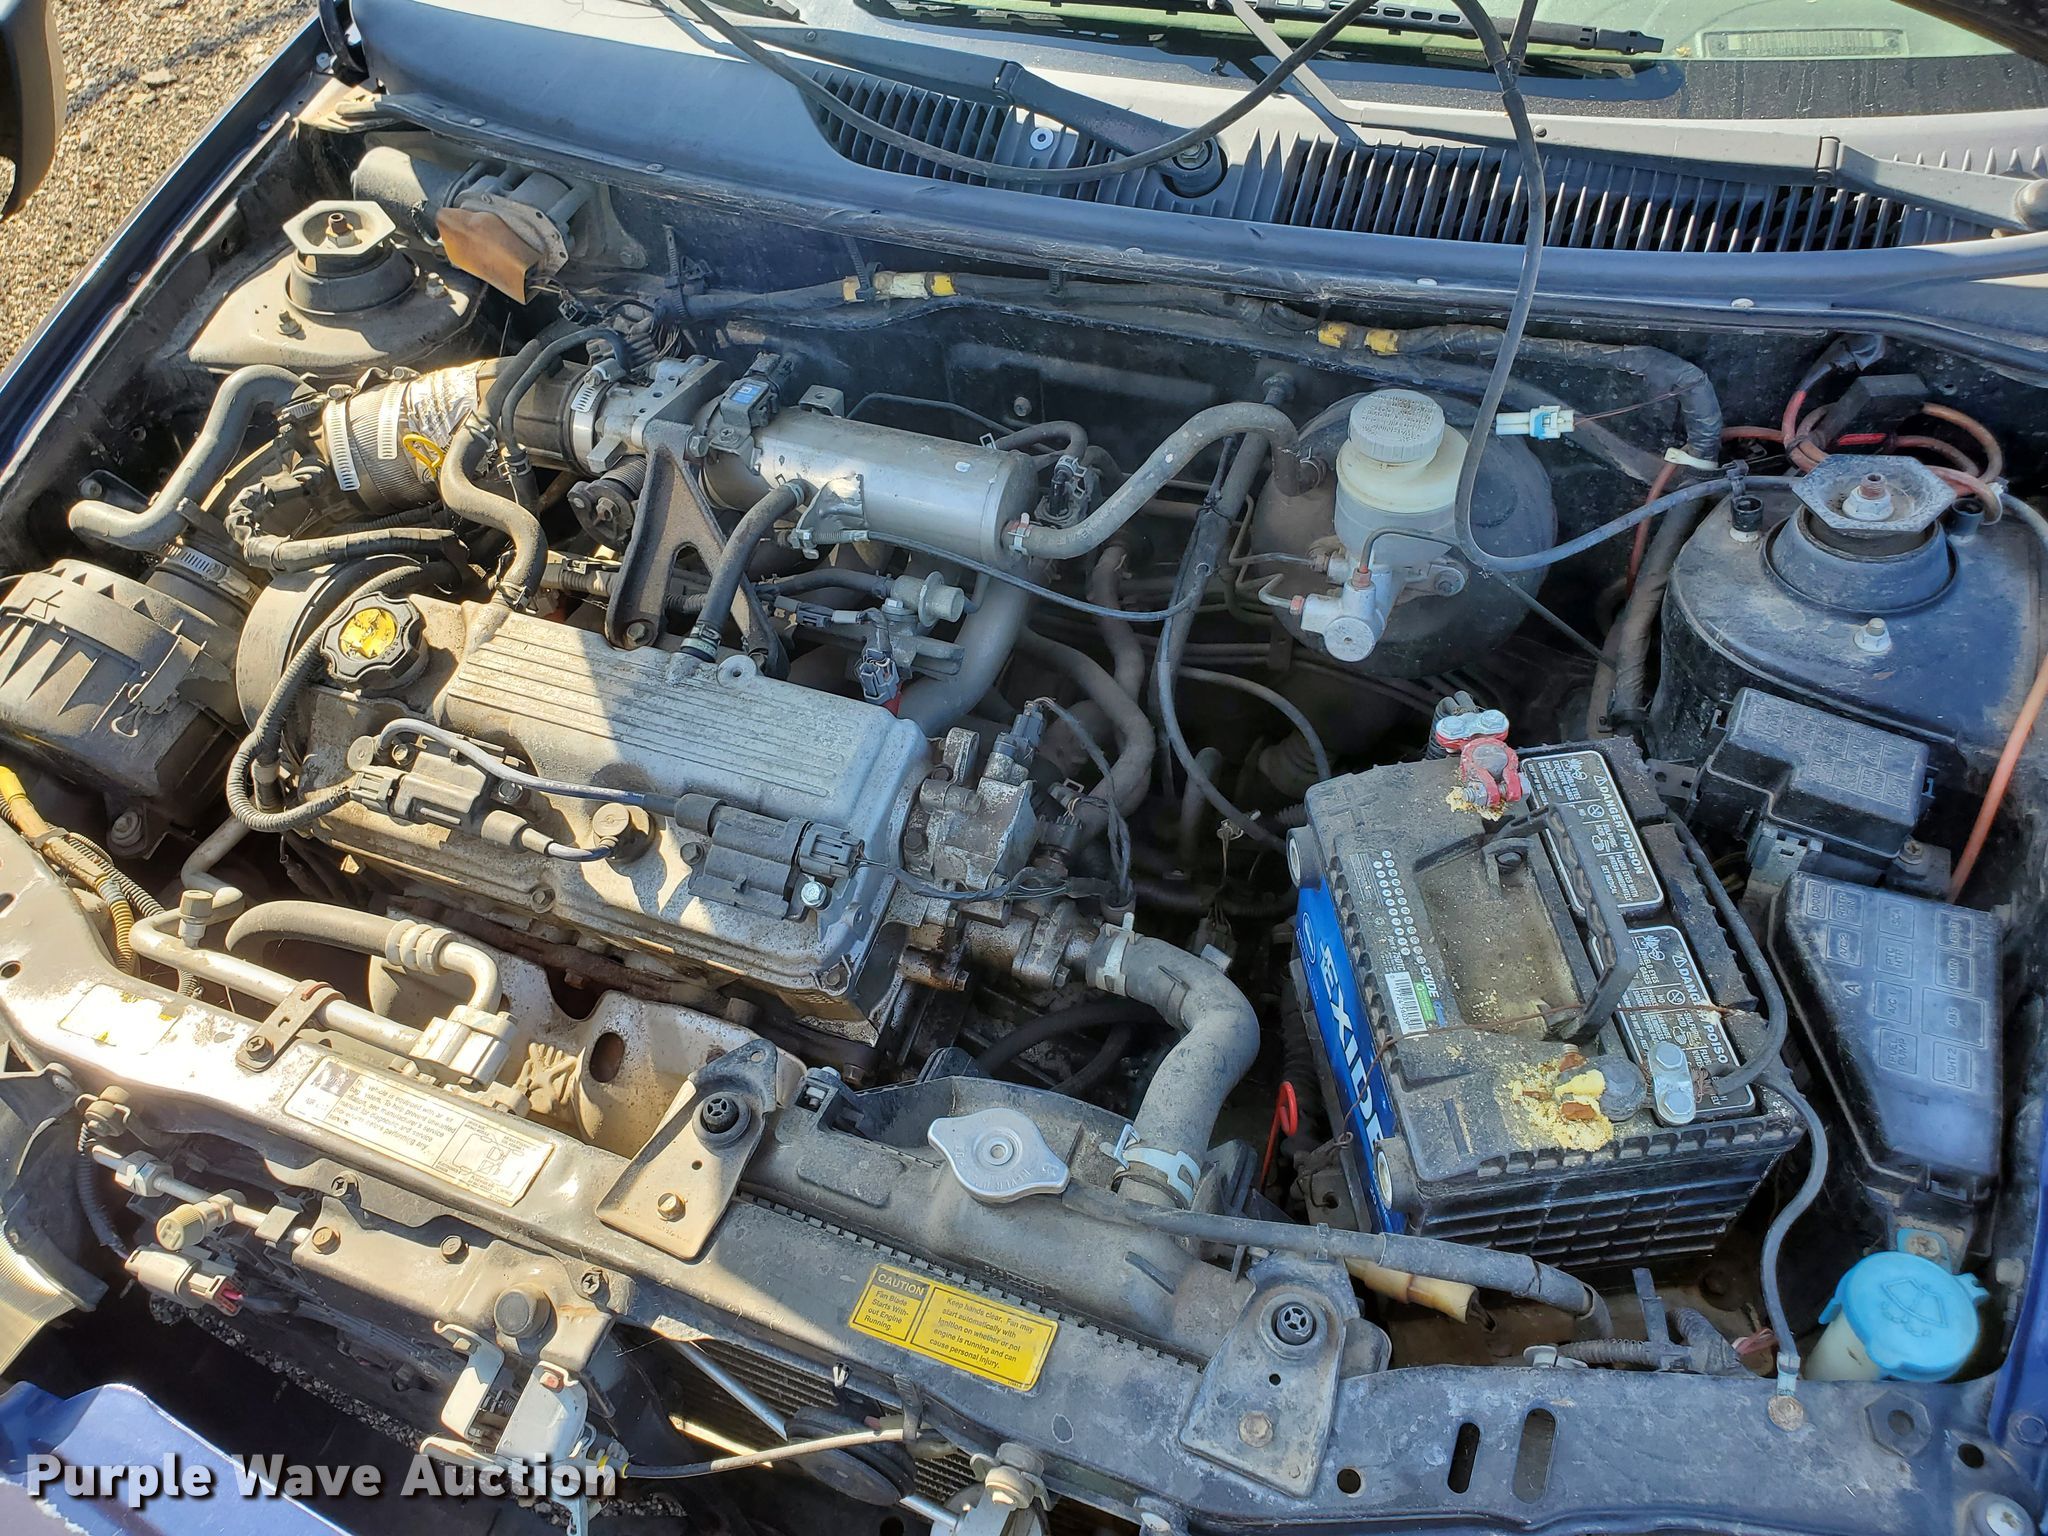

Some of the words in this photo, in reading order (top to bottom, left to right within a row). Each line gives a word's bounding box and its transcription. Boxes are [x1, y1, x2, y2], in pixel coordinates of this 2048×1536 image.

[1594, 824, 1605, 836] ACID
[1599, 786, 1625, 831] DANGER/
[1620, 835, 1644, 873] POISON
[1602, 824, 1617, 847] SULFURIC
[1614, 854, 1627, 869] FLUSH
[1622, 871, 1633, 883] EYES
[1628, 884, 1639, 897] WITH
[1420, 965, 1438, 998] EXIDE
[1638, 966, 1653, 984] GASES
[1648, 969, 1660, 983] EYES
[1655, 993, 1666, 1004] NO
[1845, 982, 1858, 994] A
[1675, 1013, 1685, 1026] ACID
[1683, 1012, 1701, 1040] SULFURIC
[1703, 1025, 1728, 1062] POISO
[1898, 1037, 1907, 1066] PUMP
[1699, 1049, 1712, 1064] FLUS
[159, 1220, 182, 1248] H
[877, 1273, 924, 1296] CAUTION
[871, 1299, 892, 1310] Starts
[875, 1290, 888, 1299] Fan
[889, 1295, 907, 1306] Blade
[863, 1315, 893, 1331] Running.
[867, 1307, 878, 1315] out
[879, 1311, 902, 1324] Engine
[942, 1308, 957, 1317] start
[957, 1313, 1001, 1334] automatically
[1002, 1329, 1016, 1338] with
[946, 1298, 963, 1309] Keep
[963, 1304, 985, 1316] hands
[1006, 1318, 1019, 1327] Fan
[1018, 1324, 1033, 1334] may
[929, 1338, 949, 1349] cause
[949, 1345, 979, 1361] personal
[933, 1328, 956, 1341] engine
[963, 1338, 990, 1353] running
[990, 1348, 1003, 1357] and
[1003, 1353, 1017, 1362] can
[973, 1330, 999, 1344] whether
[1008, 1343, 1020, 1352] not
